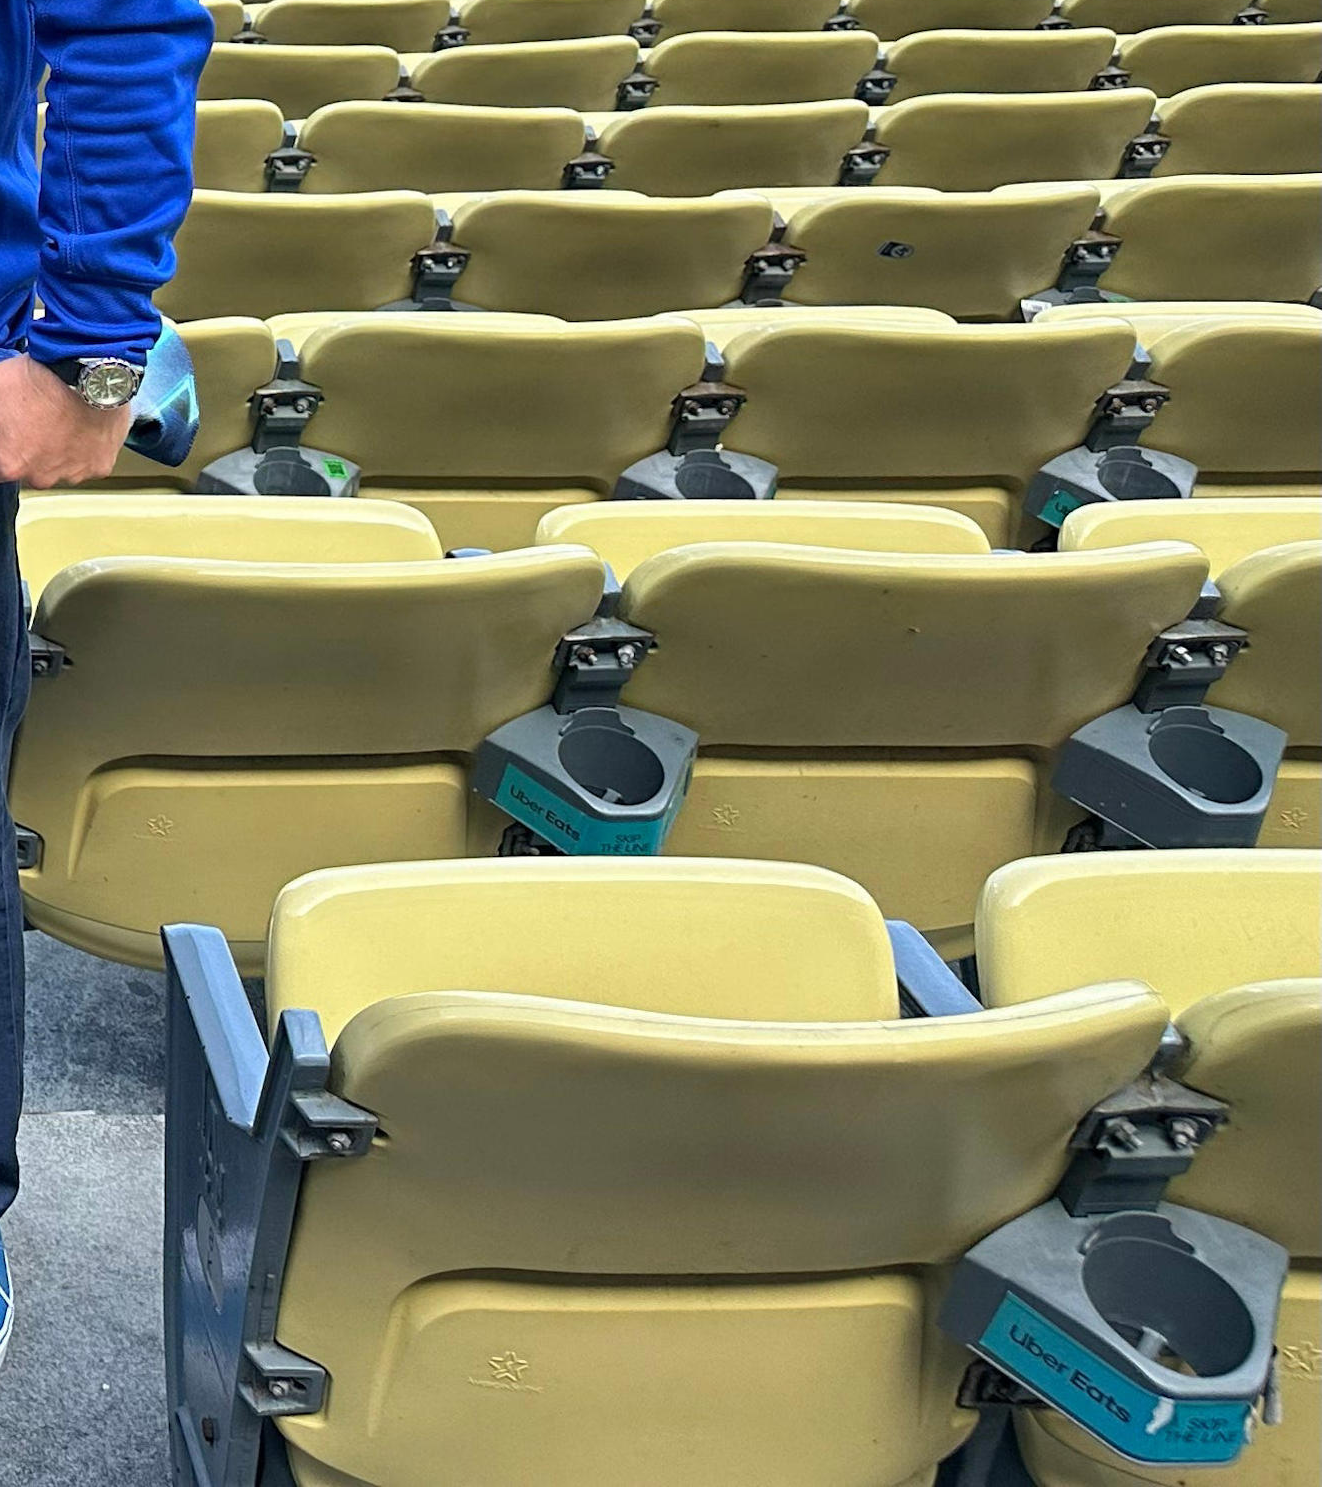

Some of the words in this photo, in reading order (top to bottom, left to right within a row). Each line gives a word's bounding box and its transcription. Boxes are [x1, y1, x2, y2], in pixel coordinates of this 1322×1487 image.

[509, 784, 544, 813] Uber
[545, 810, 581, 842] Eats
[601, 843, 622, 853] THE
[624, 843, 649, 853] LINE
[615, 834, 642, 843] SKIP
[1008, 1324, 1068, 1375] Uber
[1068, 1368, 1132, 1424] Eats
